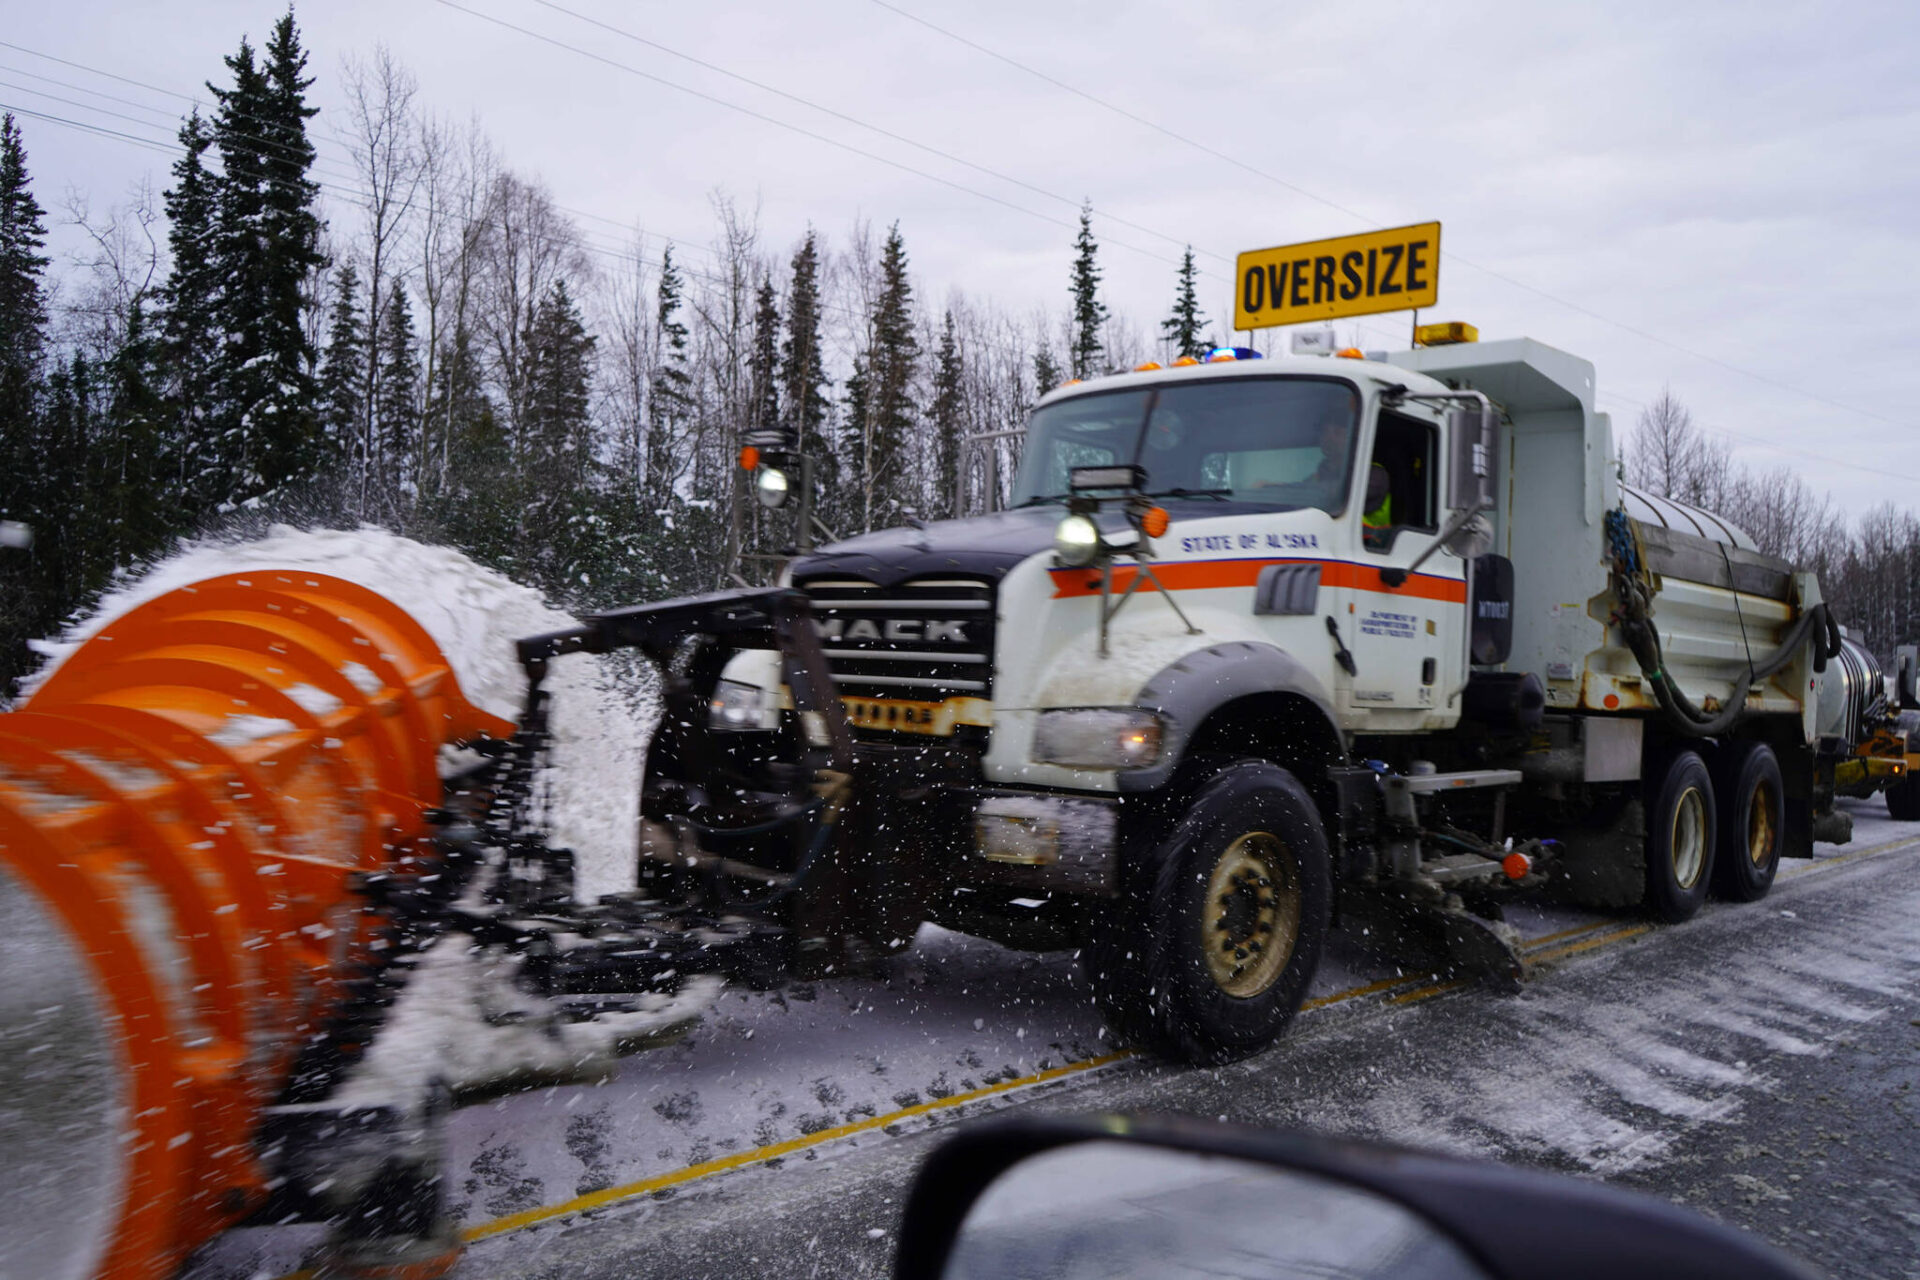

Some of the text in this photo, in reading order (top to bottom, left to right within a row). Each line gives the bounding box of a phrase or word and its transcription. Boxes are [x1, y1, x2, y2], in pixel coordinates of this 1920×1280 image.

[1243, 240, 1429, 314] OVERSIZE
[1180, 535, 1233, 552] STATE
[1237, 533, 1259, 550] OF
[810, 618, 970, 642] MACK
